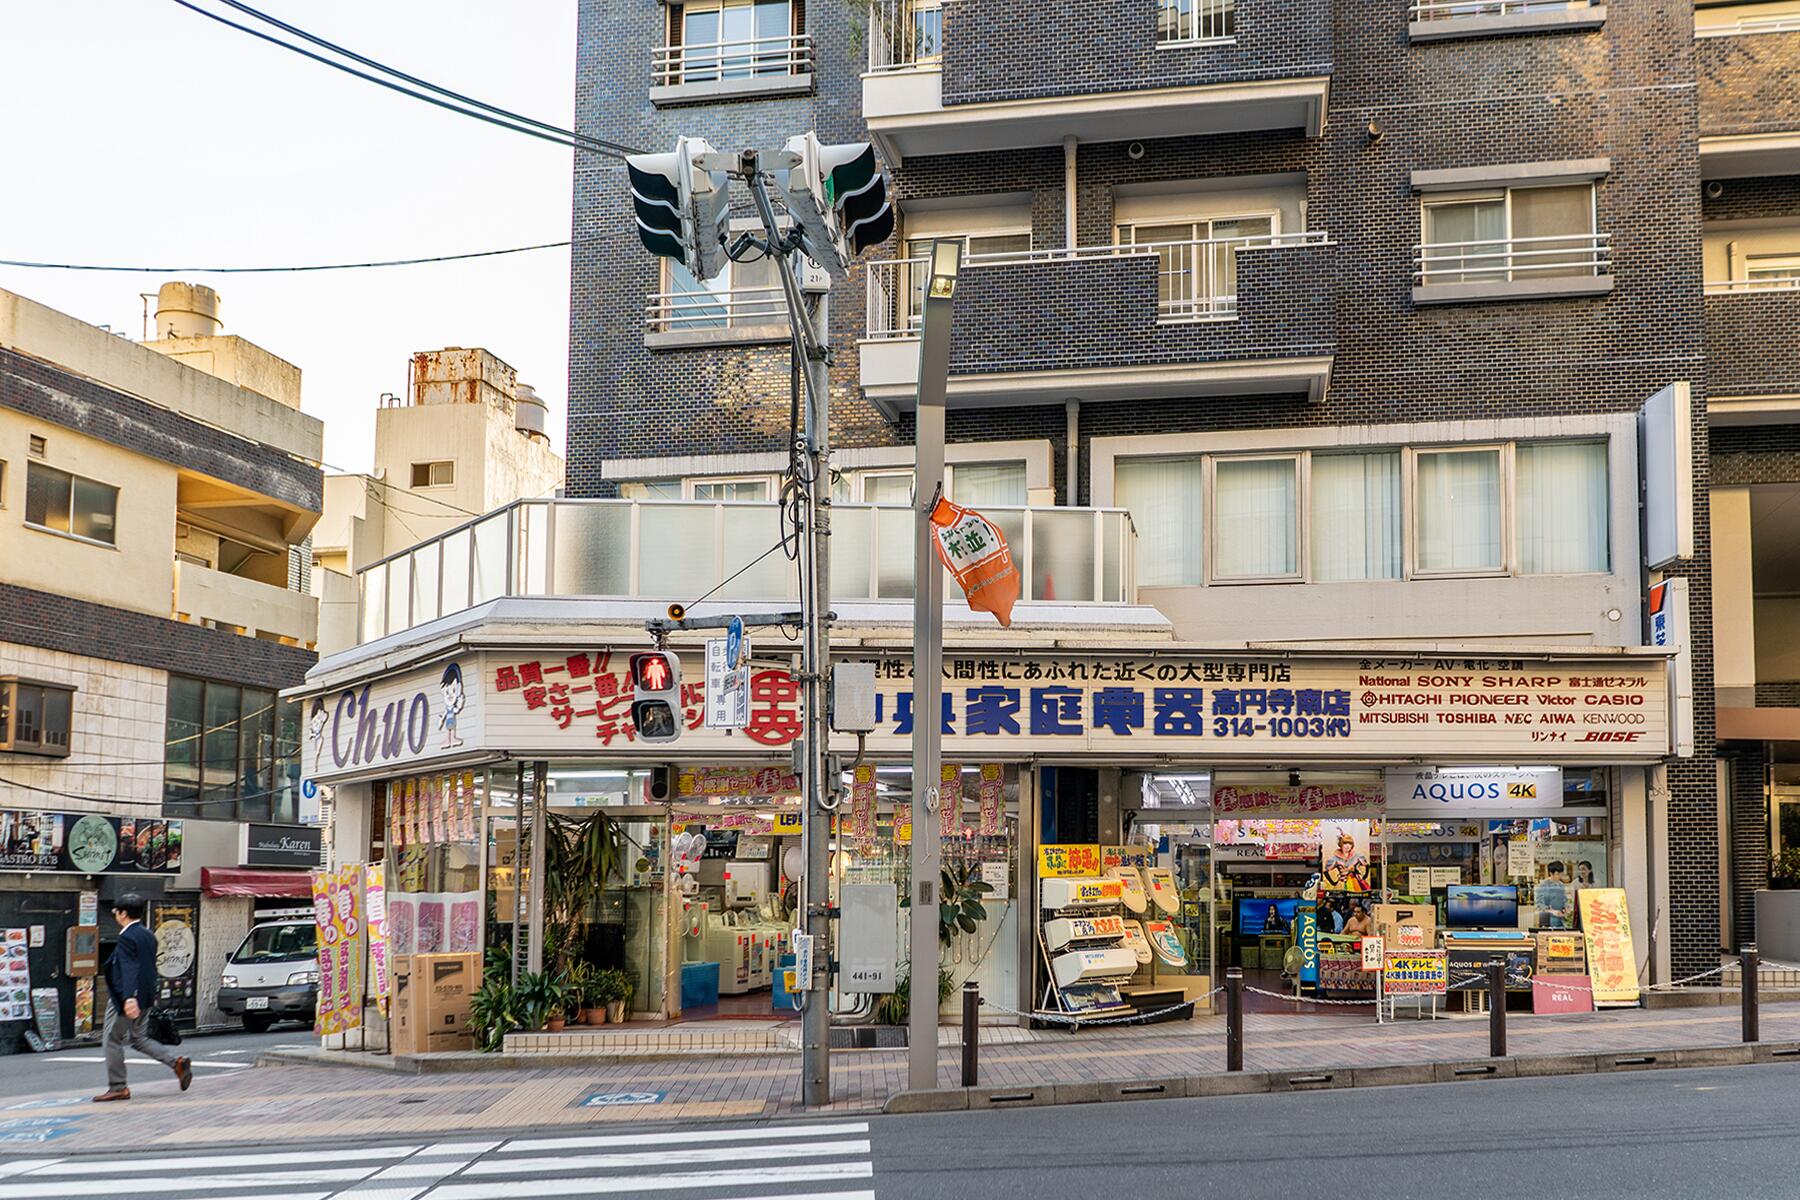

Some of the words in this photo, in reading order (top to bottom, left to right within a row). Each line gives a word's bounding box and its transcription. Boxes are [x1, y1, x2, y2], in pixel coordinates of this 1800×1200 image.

[1359, 675, 1411, 687] National
[1417, 675, 1474, 687] SONY
[1482, 676, 1562, 688] SHARP
[1568, 676, 1649, 688] 富士通ゼネラル
[1211, 688, 1352, 716] 高円寺南店
[1378, 694, 1442, 705] HITACHI
[1449, 694, 1529, 705] PIONEER
[1536, 694, 1577, 706] Victor
[1584, 694, 1644, 706] CASIO
[1359, 713, 1429, 724] MITSUBISHI
[1436, 713, 1497, 724] TOSHIBA
[1504, 713, 1533, 724] NEC
[1539, 713, 1576, 724] AIWA
[1583, 713, 1646, 725] KENWOOD
[332, 684, 430, 769] Chuo
[1531, 731, 1567, 743] リンナイ
[1574, 731, 1647, 743] BOSE
[1412, 783, 1500, 802] AQUOS
[1509, 783, 1534, 797] 4K
[279, 836, 311, 850] Karen
[38, 855, 59, 866] PUB
[1303, 915, 1315, 970] AQUOS
[1394, 960, 1410, 969] 4K
[1411, 960, 1433, 969] テレビ
[1449, 961, 1473, 969] AQUOS
[1551, 993, 1574, 1002] REAL
